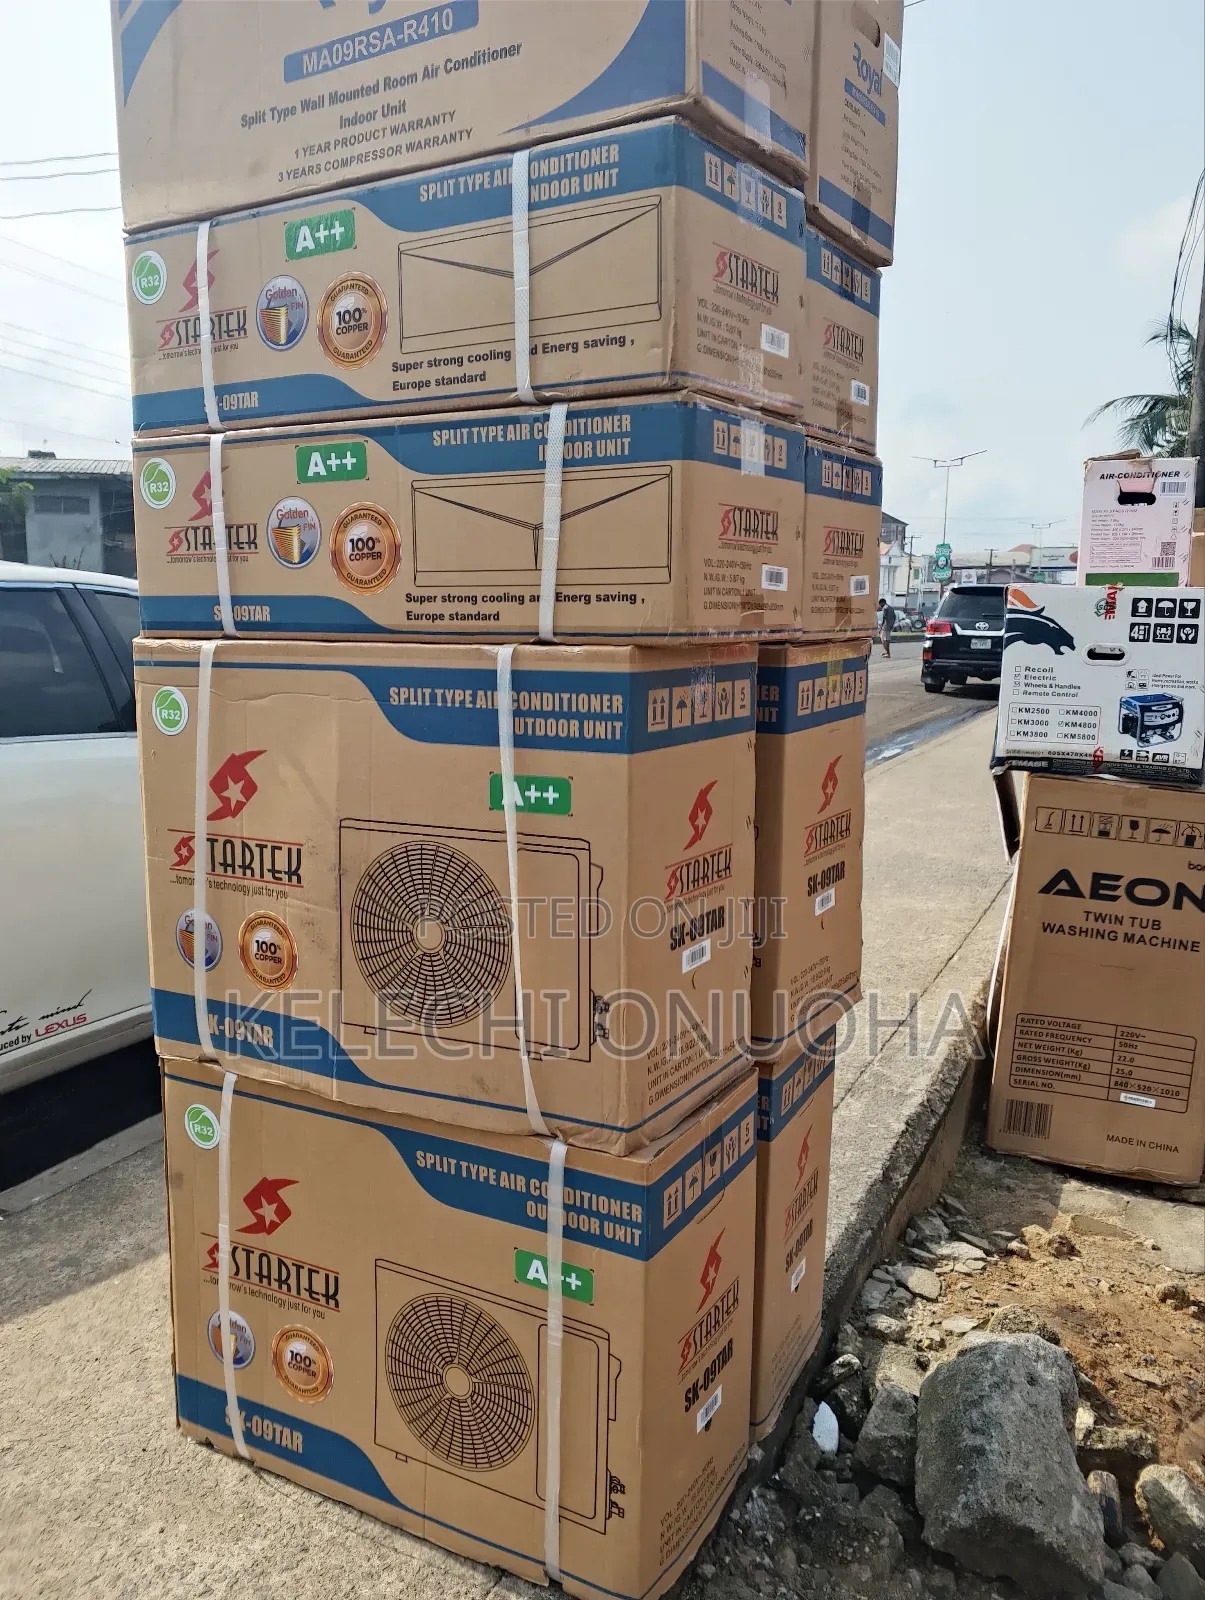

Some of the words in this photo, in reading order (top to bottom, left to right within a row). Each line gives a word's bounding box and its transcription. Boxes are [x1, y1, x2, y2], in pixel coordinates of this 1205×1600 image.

[302, 8, 453, 75] MA09RSA-R410
[853, 42, 882, 97] Royal
[240, 110, 267, 130] Split
[269, 104, 297, 125] Type
[300, 95, 325, 113] Wall
[328, 80, 380, 107] Mounted
[383, 74, 418, 95] Room
[422, 65, 441, 81] Air
[444, 42, 522, 74] Conditioner
[339, 109, 378, 130] Indoor
[381, 99, 407, 119] Unit
[294, 148, 300, 159] 1
[302, 139, 331, 158] YEAR
[334, 127, 387, 151] PRODUCT
[390, 110, 456, 137] WARRANTY
[277, 171, 284, 182] 3
[286, 163, 322, 181] YEARS
[324, 144, 403, 173] COMPRESSOR
[405, 128, 473, 154] WARRANTY
[419, 178, 457, 203] SPLIT
[458, 170, 490, 194] TYPE
[529, 143, 620, 180] ONDITIONER
[529, 177, 580, 203] NDOOR
[583, 168, 619, 192] UNIT
[295, 220, 345, 253] A++
[140, 275, 161, 289] R32
[728, 252, 780, 304] STARTEK
[265, 286, 298, 302] Golden
[330, 282, 370, 303] GUARANTEED
[289, 300, 304, 311] FIN
[335, 307, 368, 325] 100%
[335, 321, 369, 336] COPPER
[332, 340, 374, 361] GUARANTEED
[391, 360, 424, 374] Super
[427, 354, 464, 370] strong
[467, 347, 512, 365] cooling
[541, 340, 579, 355] Energ
[583, 334, 627, 350] saving
[392, 376, 432, 392] Europe
[434, 370, 487, 389] standard
[432, 428, 469, 447] SPLIT
[471, 424, 505, 444] TYPE
[506, 422, 531, 442] AIR
[596, 437, 631, 458] UNIT
[306, 451, 357, 477] A++
[1099, 470, 1180, 480] AIR-CONDITIONER
[150, 481, 170, 494] R32
[276, 507, 309, 521] Golden
[342, 512, 383, 529] GUARANTEED
[303, 522, 316, 532] FIN
[732, 506, 779, 541] STARTEK
[348, 536, 381, 552] 100%
[348, 550, 382, 562] COPPER
[346, 567, 388, 587] GUARANTEED
[405, 593, 437, 605] Super
[441, 592, 478, 606] strong
[481, 591, 525, 606] cooling
[555, 591, 592, 606] Energ
[595, 591, 637, 605] saving
[406, 610, 446, 623] Europe
[448, 610, 500, 622] standard
[1024, 674, 1057, 682] Electric
[1025, 666, 1054, 674] Recoil
[1022, 690, 1050, 698] Remote
[1024, 681, 1051, 689] Wheels
[389, 686, 432, 706] SPLIT
[434, 688, 473, 709] TYPE
[161, 709, 181, 721] R32
[1018, 707, 1050, 715] KM2500
[1065, 709, 1098, 717] KM4000
[514, 715, 580, 739] UTDOOR
[583, 720, 624, 741] UNIT
[1017, 719, 1049, 727] KM3000
[1064, 721, 1097, 729] KM4800
[1016, 730, 1048, 738] KM3800
[1063, 733, 1096, 741] KM5800
[1153, 754, 1168, 762] AVR
[813, 811, 851, 850] STARTEK
[206, 836, 302, 885] TARTEK
[679, 848, 732, 894] STARTEK
[807, 860, 846, 897] SK-09TAR
[213, 878, 251, 897] technology
[251, 883, 264, 898] just
[264, 885, 275, 898] for
[275, 889, 289, 902] you
[1038, 868, 1205, 914] AEON
[250, 918, 284, 936] GUARANTEED
[670, 905, 725, 951] SK-09TAR
[1083, 910, 1124, 926] TWIN
[1129, 916, 1161, 931] TUB
[1042, 922, 1118, 942] WASHING
[1123, 932, 1200, 953] MACHINE
[254, 953, 283, 965] COPPER
[252, 967, 286, 985] GUARANTEED
[21, 1033, 32, 1043] by
[35, 1013, 87, 1038] LEXUS
[208, 1013, 274, 1048] K-09TAR
[1020, 1017, 1045, 1026] RATED
[1047, 1020, 1082, 1030] VOLTAGE
[1019, 1029, 1044, 1038] RATED
[1046, 1032, 1092, 1044] FREQUENCY
[1018, 1042, 1032, 1050] NET
[1034, 1043, 1066, 1053] WEIGHT
[1067, 1047, 1083, 1057] (Kg)
[1118, 1042, 1138, 1050] 50Hz
[1016, 1054, 1042, 1063] GROSS
[1043, 1057, 1091, 1071] WEIGHT(Kg)
[1117, 1055, 1135, 1063] 22.0
[1015, 1066, 1081, 1082] DIMENSION(mm)
[1115, 1068, 1133, 1076] 25.0
[1013, 1078, 1039, 1088] SERIAL
[1041, 1082, 1056, 1090] NO.
[194, 1123, 214, 1137] R32
[1106, 1134, 1134, 1146] MADE
[1136, 1139, 1146, 1148] IN
[1148, 1142, 1180, 1154] CHINA
[416, 1150, 457, 1176] SPLIT
[460, 1160, 497, 1186] TYPE
[499, 1171, 527, 1194] AIR
[603, 1221, 642, 1247] UNIT
[231, 1245, 340, 1309] STARTEK
[248, 1286, 287, 1311] technology
[287, 1299, 301, 1311] just
[301, 1302, 312, 1315] for
[312, 1307, 326, 1321] you
[693, 1280, 739, 1356] STARTEK
[287, 1361, 317, 1379] COPPER
[684, 1338, 734, 1413] SK-09TAR
